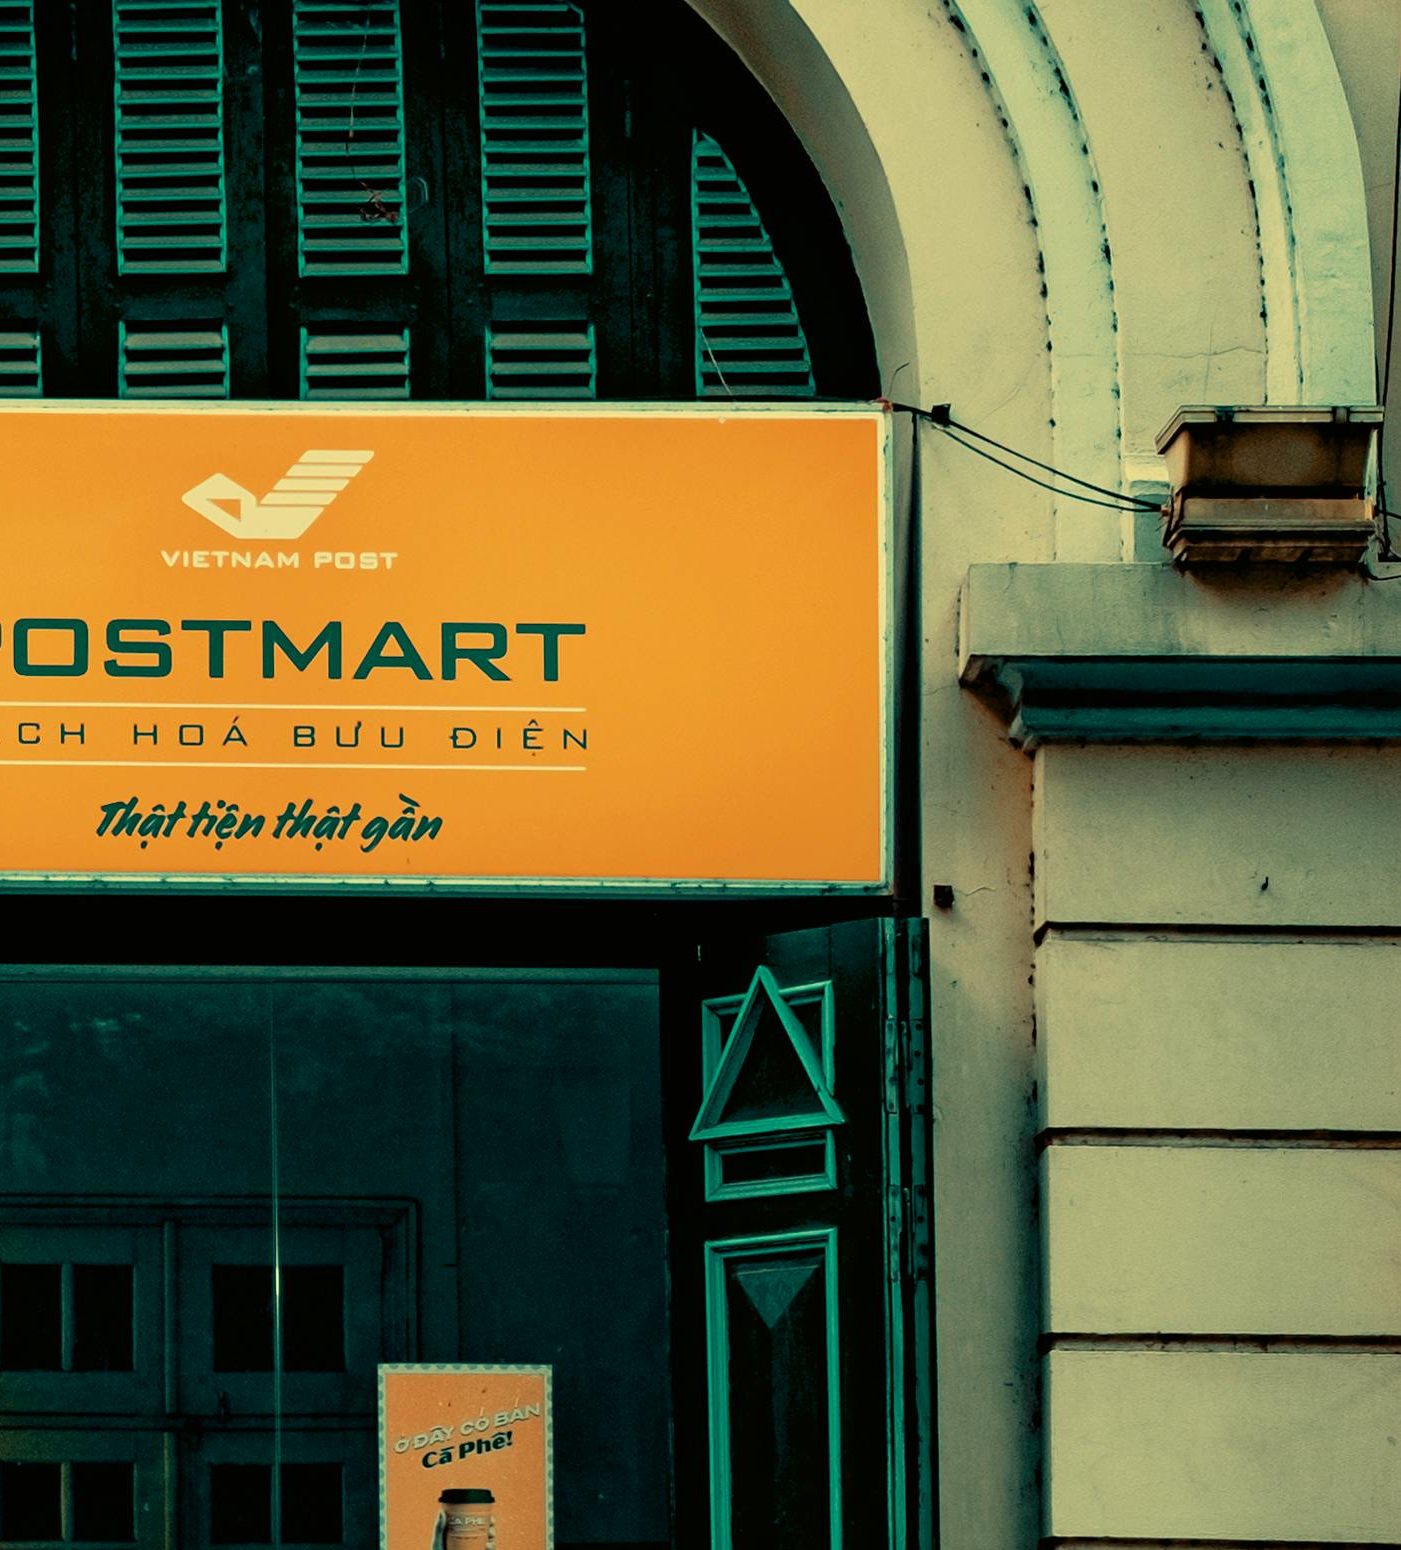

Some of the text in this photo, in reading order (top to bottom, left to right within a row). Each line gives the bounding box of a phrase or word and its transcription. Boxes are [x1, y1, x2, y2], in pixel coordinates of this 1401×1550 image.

[160, 550, 398, 570] VIETNAM POST
[133, 716, 248, 746] HOÁ
[293, 721, 404, 748] BƯU
[449, 719, 587, 756] ĐIỆN
[96, 793, 444, 853] Thật tiện thật gần
